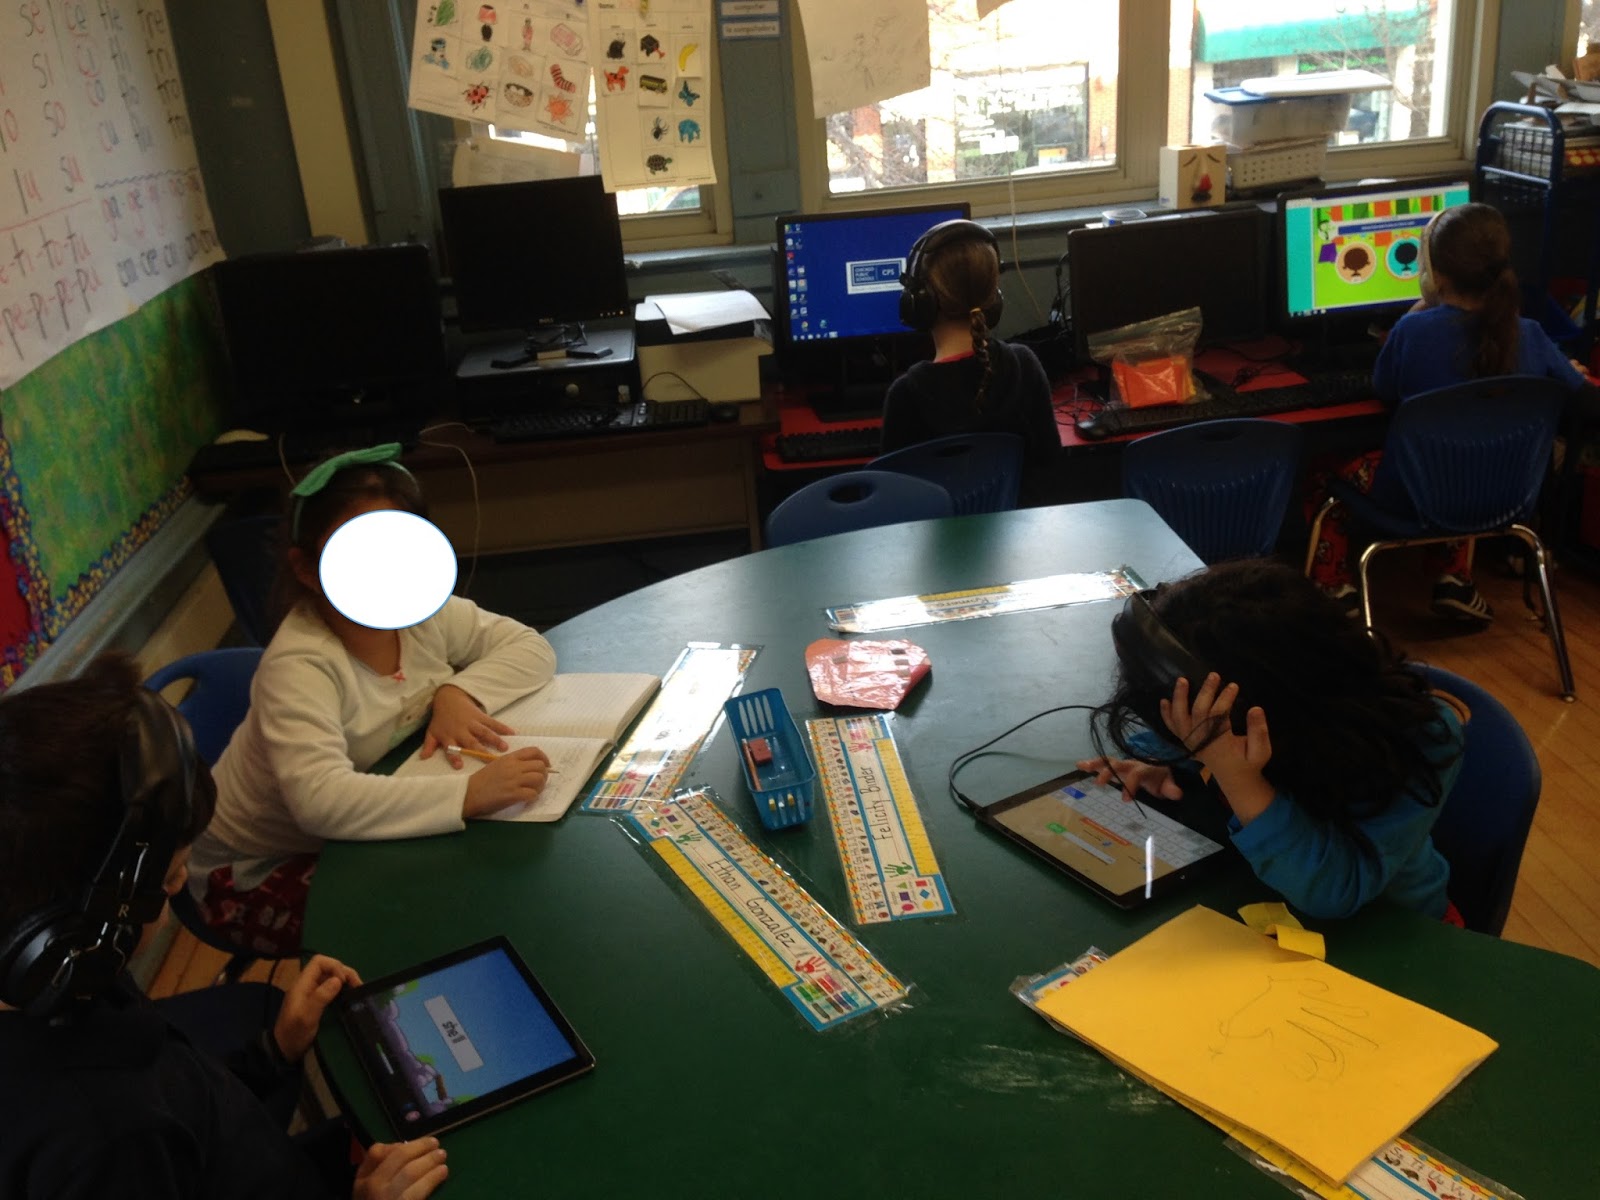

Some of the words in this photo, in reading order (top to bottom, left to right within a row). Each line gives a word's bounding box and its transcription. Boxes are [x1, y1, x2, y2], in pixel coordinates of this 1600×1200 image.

[881, 268, 895, 276] CPS
[859, 766, 881, 794] Binder
[865, 799, 893, 840] Felicity
[708, 858, 741, 891] Ethan
[746, 897, 796, 948] Gonzalez
